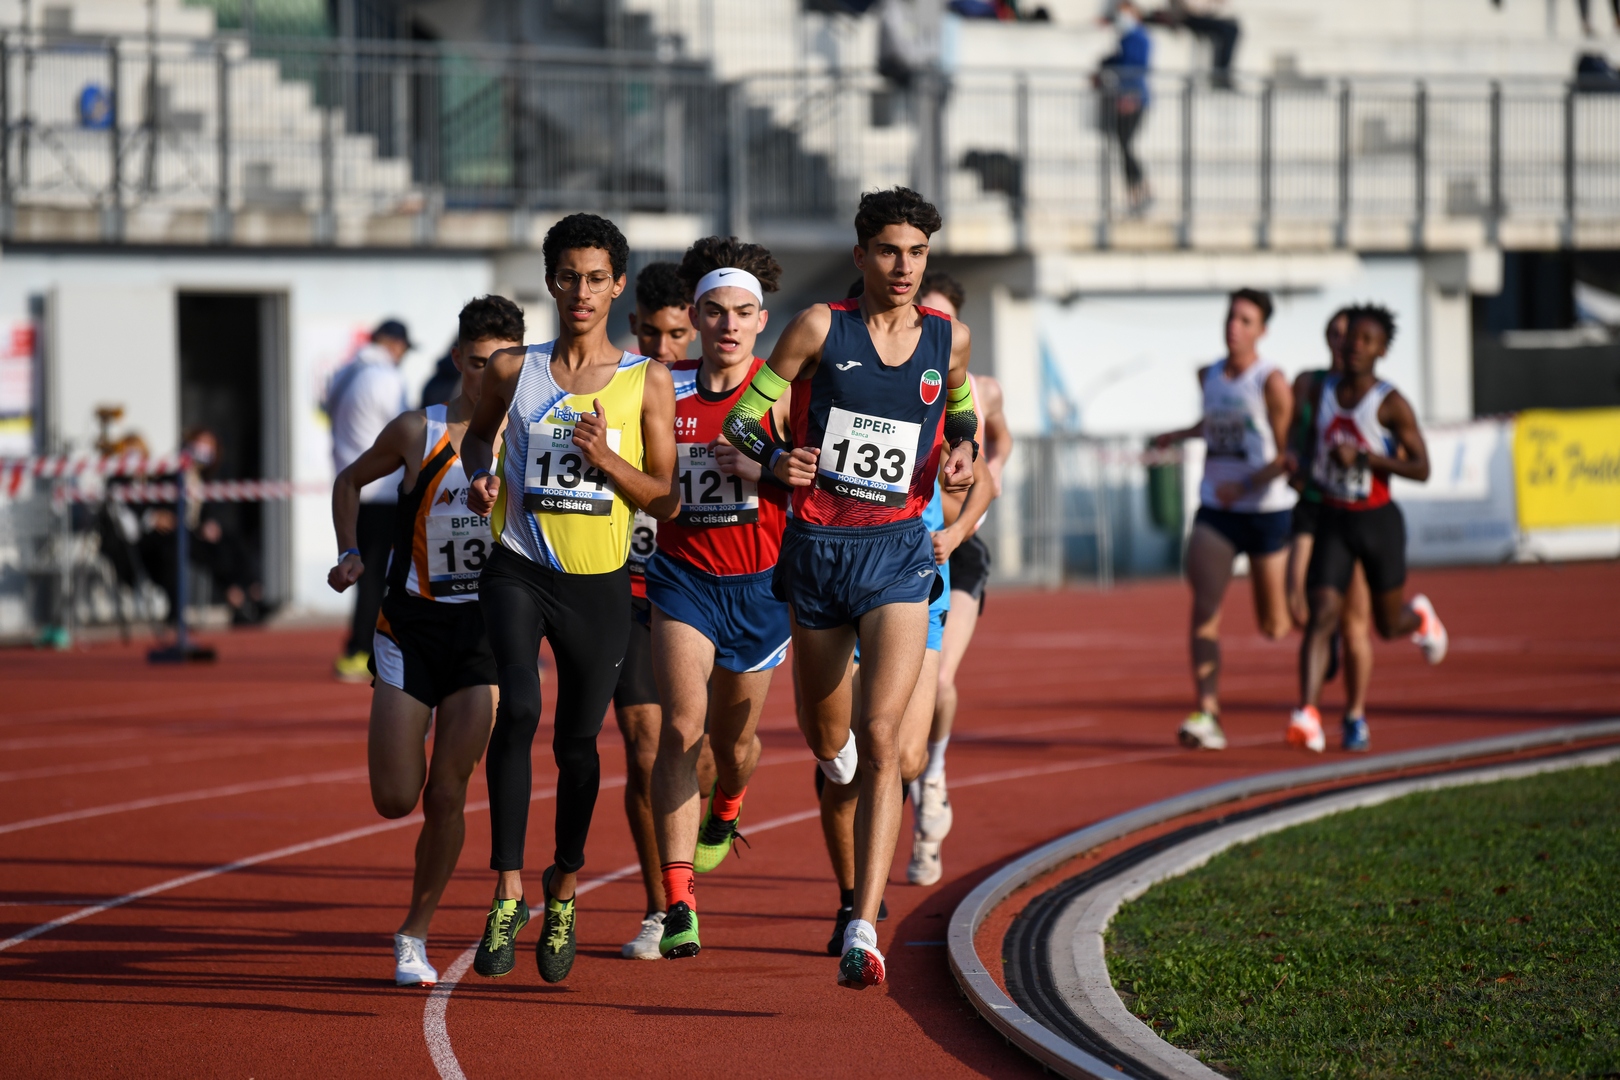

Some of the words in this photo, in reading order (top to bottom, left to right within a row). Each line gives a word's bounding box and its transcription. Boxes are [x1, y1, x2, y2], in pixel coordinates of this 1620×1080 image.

[853, 417, 896, 434] BPER:
[851, 430, 869, 438] Banca
[689, 447, 715, 458] BPE
[833, 439, 906, 483] 133
[536, 451, 608, 491] 134
[679, 470, 743, 504] 121
[838, 474, 869, 487] MODENA
[870, 481, 888, 490] 2020
[543, 489, 573, 497] MODENA
[556, 499, 593, 511] cisalfa
[702, 514, 738, 523] cisalfa
[439, 538, 494, 573] 13
